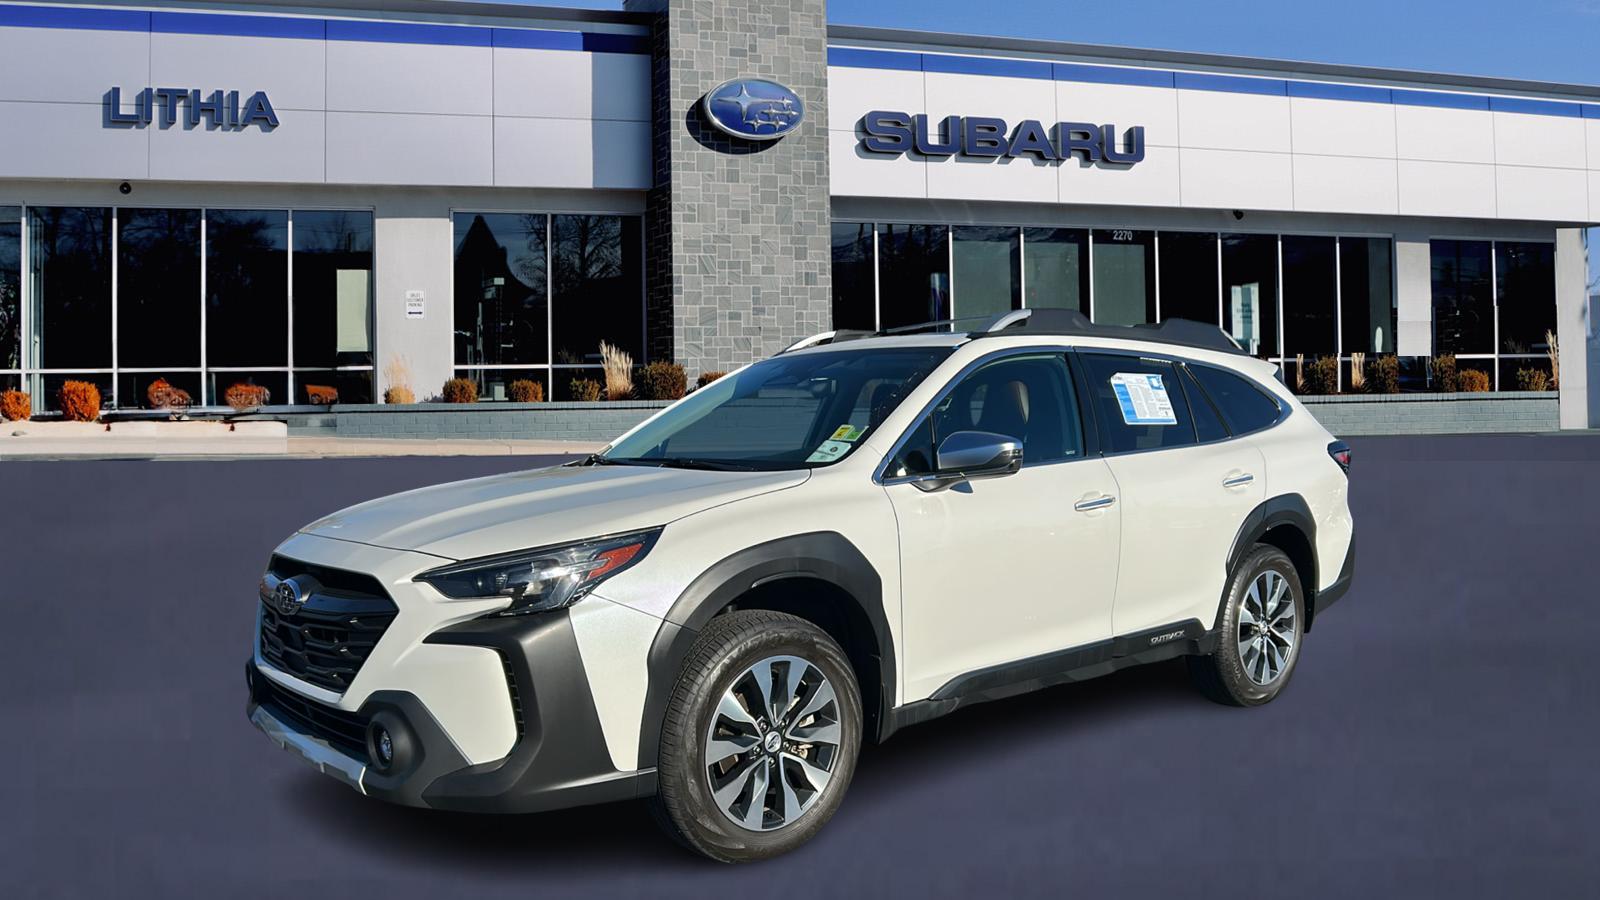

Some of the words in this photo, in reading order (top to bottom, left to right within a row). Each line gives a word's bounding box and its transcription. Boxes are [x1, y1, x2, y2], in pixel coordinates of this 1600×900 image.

[109, 86, 280, 127] LITHIA
[864, 110, 1145, 164] SUBARU
[1112, 230, 1133, 241] 2270
